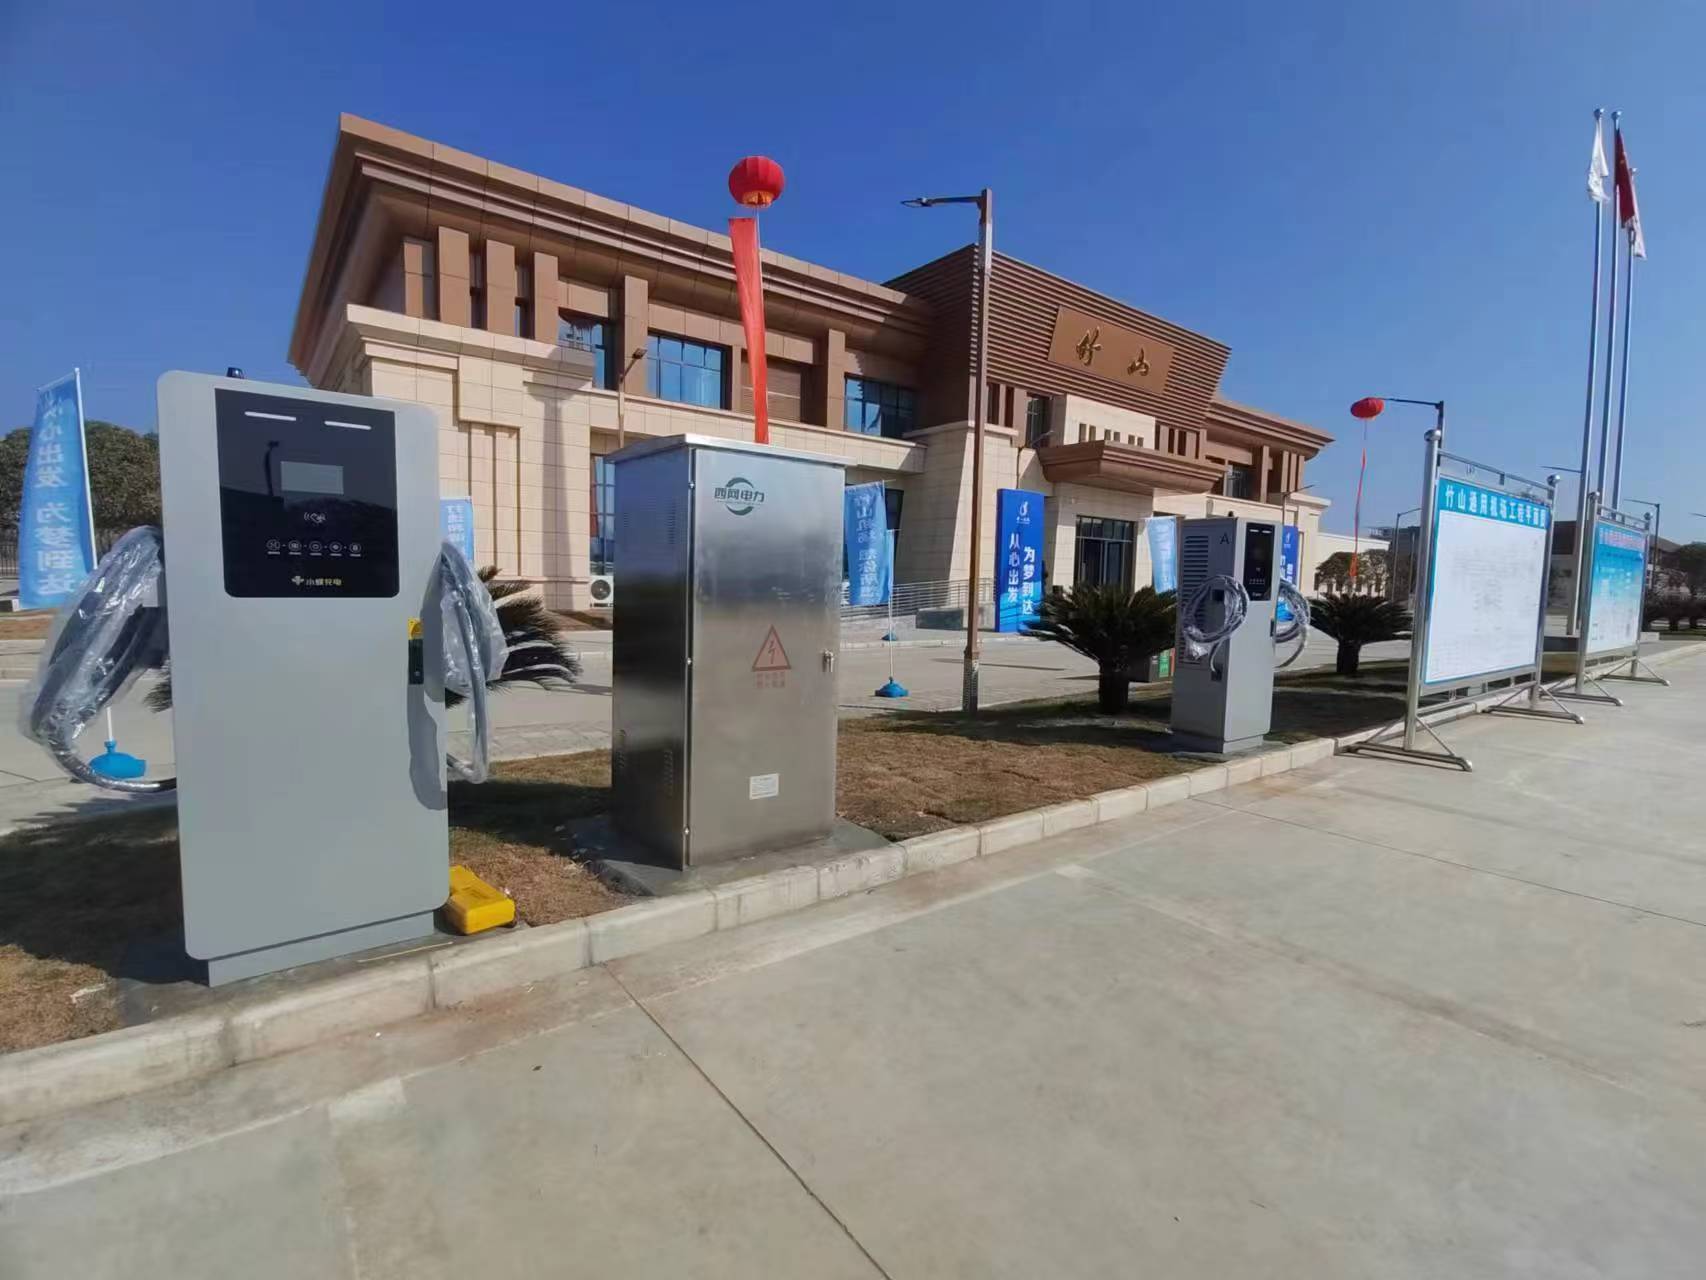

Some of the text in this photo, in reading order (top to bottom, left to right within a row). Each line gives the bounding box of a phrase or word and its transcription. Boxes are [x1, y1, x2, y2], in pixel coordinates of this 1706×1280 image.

[1007, 533, 1021, 604] 从心出发
[1219, 533, 1230, 545] A
[1023, 546, 1036, 616] 为梦到达
